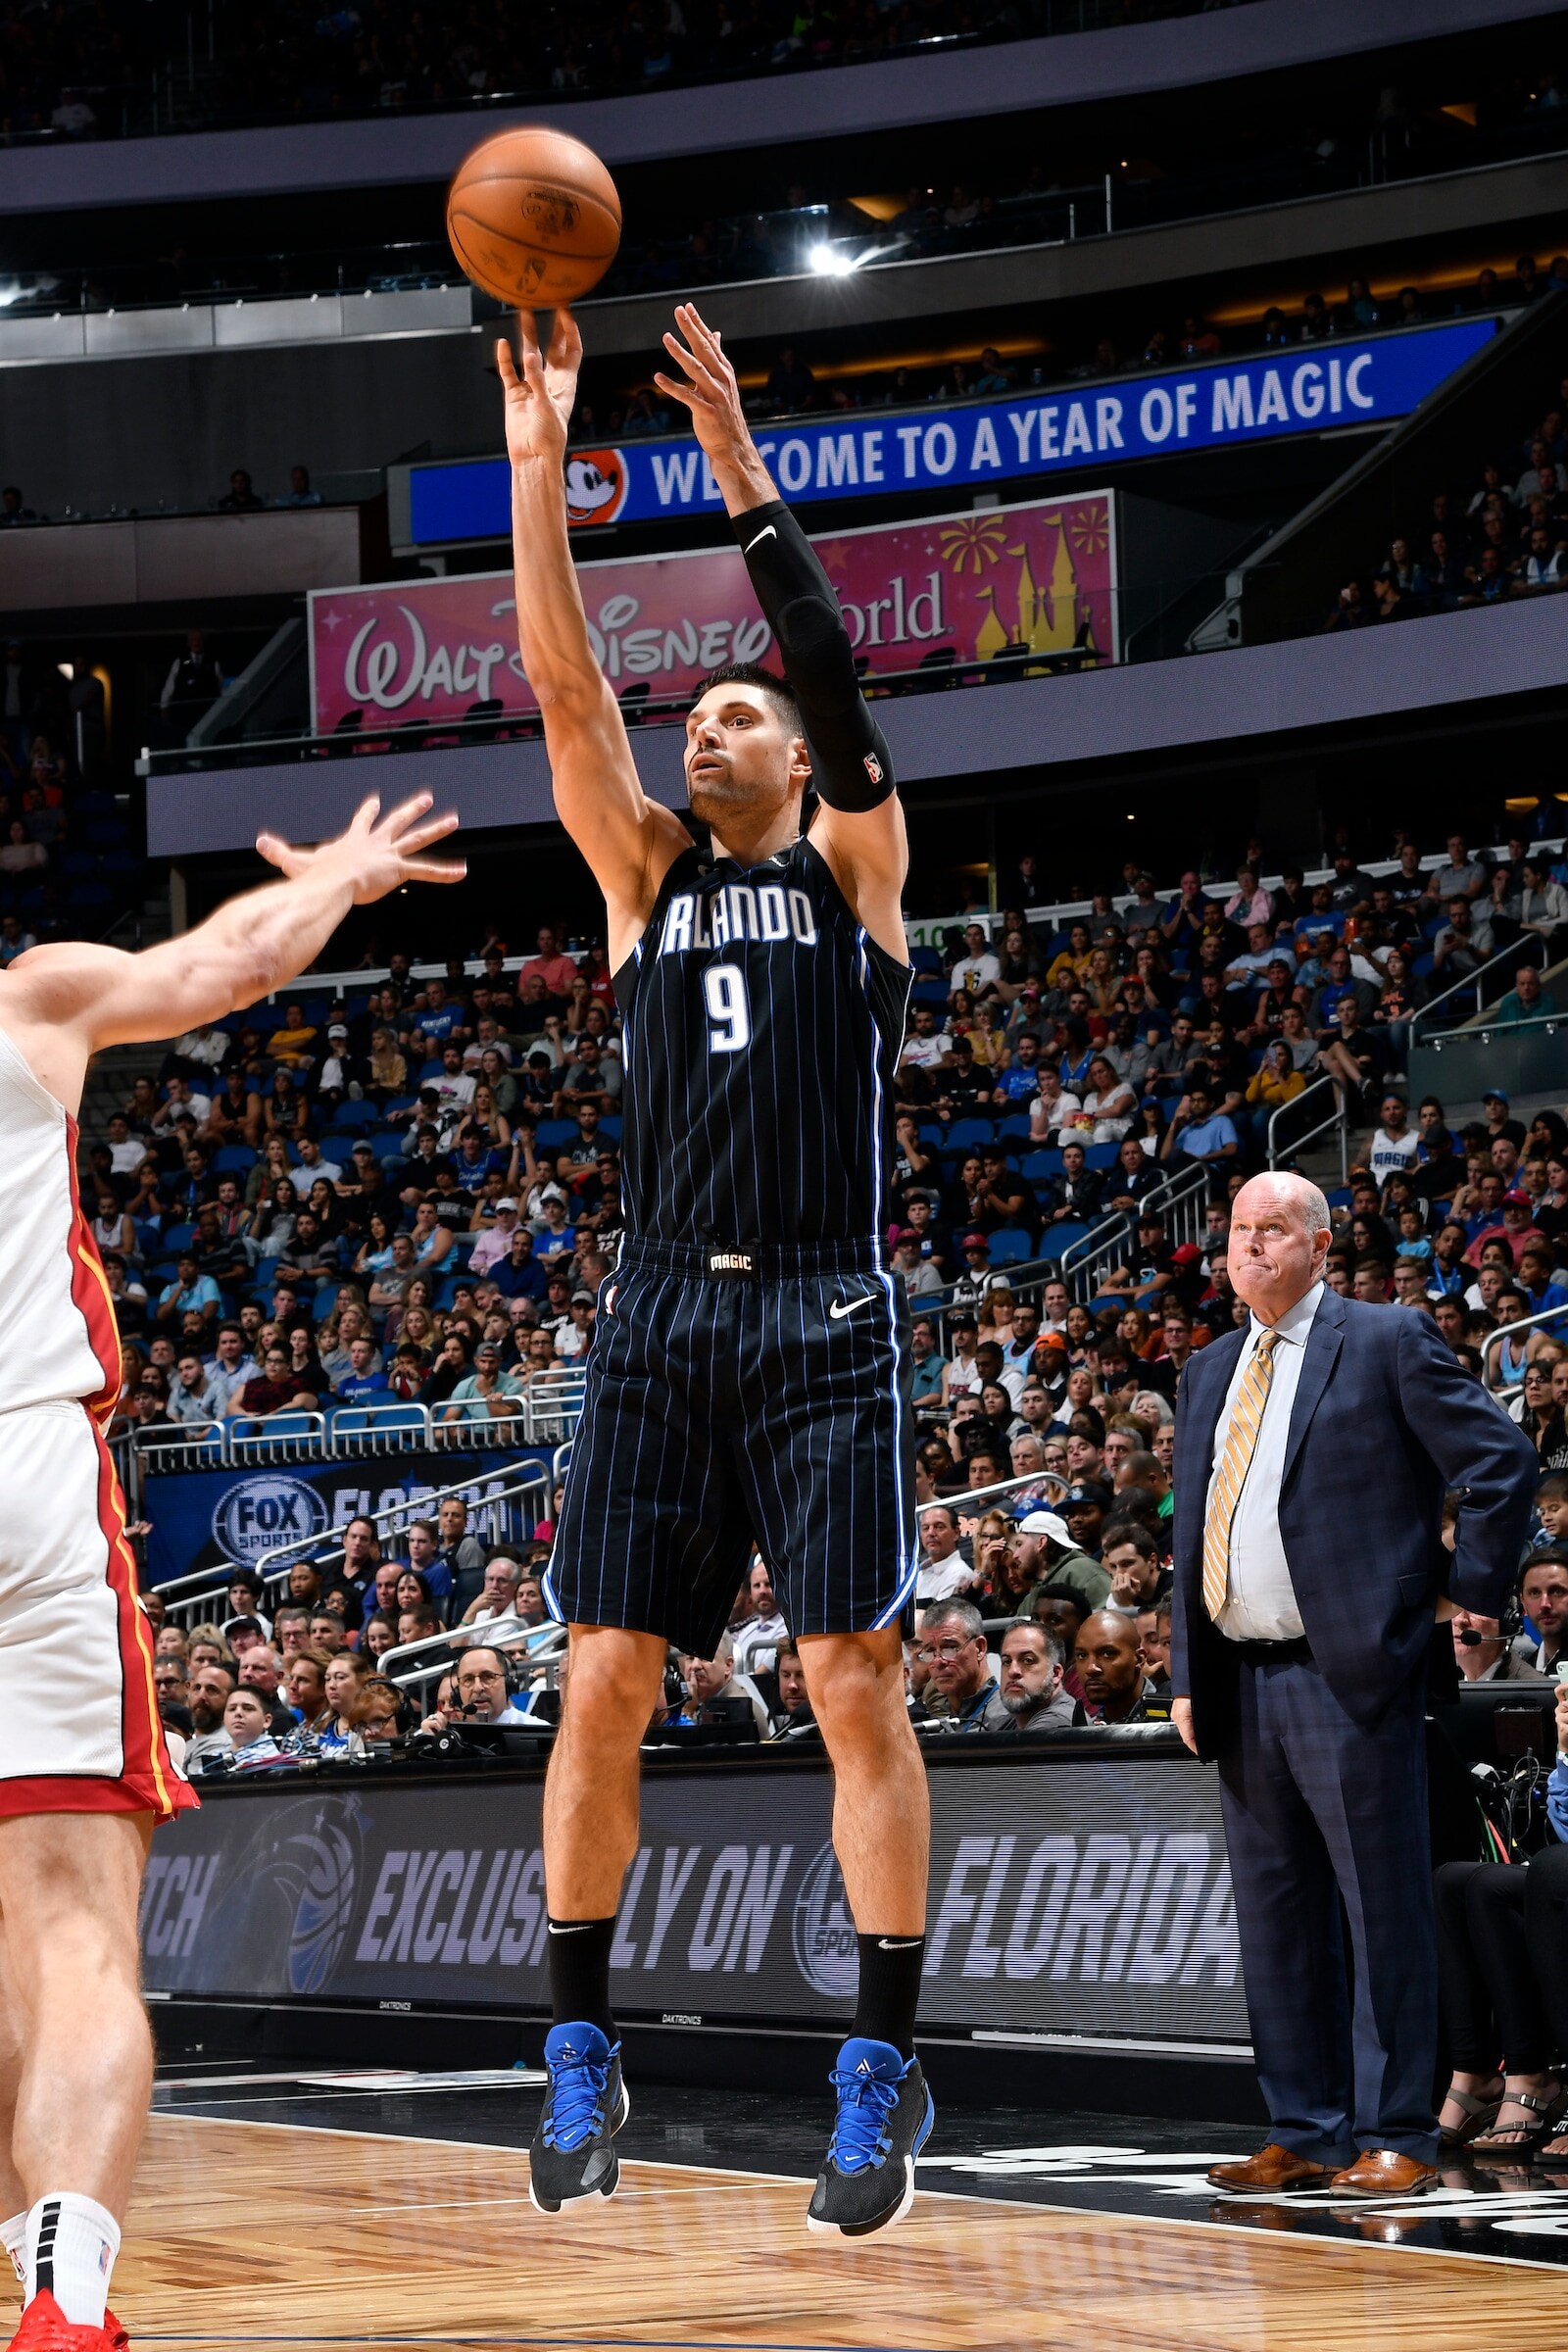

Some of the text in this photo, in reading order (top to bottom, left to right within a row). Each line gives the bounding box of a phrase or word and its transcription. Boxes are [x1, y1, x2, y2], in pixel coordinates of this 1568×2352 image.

[651, 354, 1374, 506] WEOME TO A YEAR OF MAGIC
[833, 571, 946, 649] orld
[656, 884, 818, 964] RLANDO
[704, 963, 752, 1053] 9
[1374, 1152, 1413, 1167] MAGIC
[710, 1254, 752, 1271] MAGIC
[238, 1494, 300, 1534] FOX
[144, 1834, 1243, 1986] TCH EXCLUSLY ON FLORIDA
[378, 2000, 412, 2011] DAKTRONICS
[662, 2014, 703, 2026] DAKTRONICS
